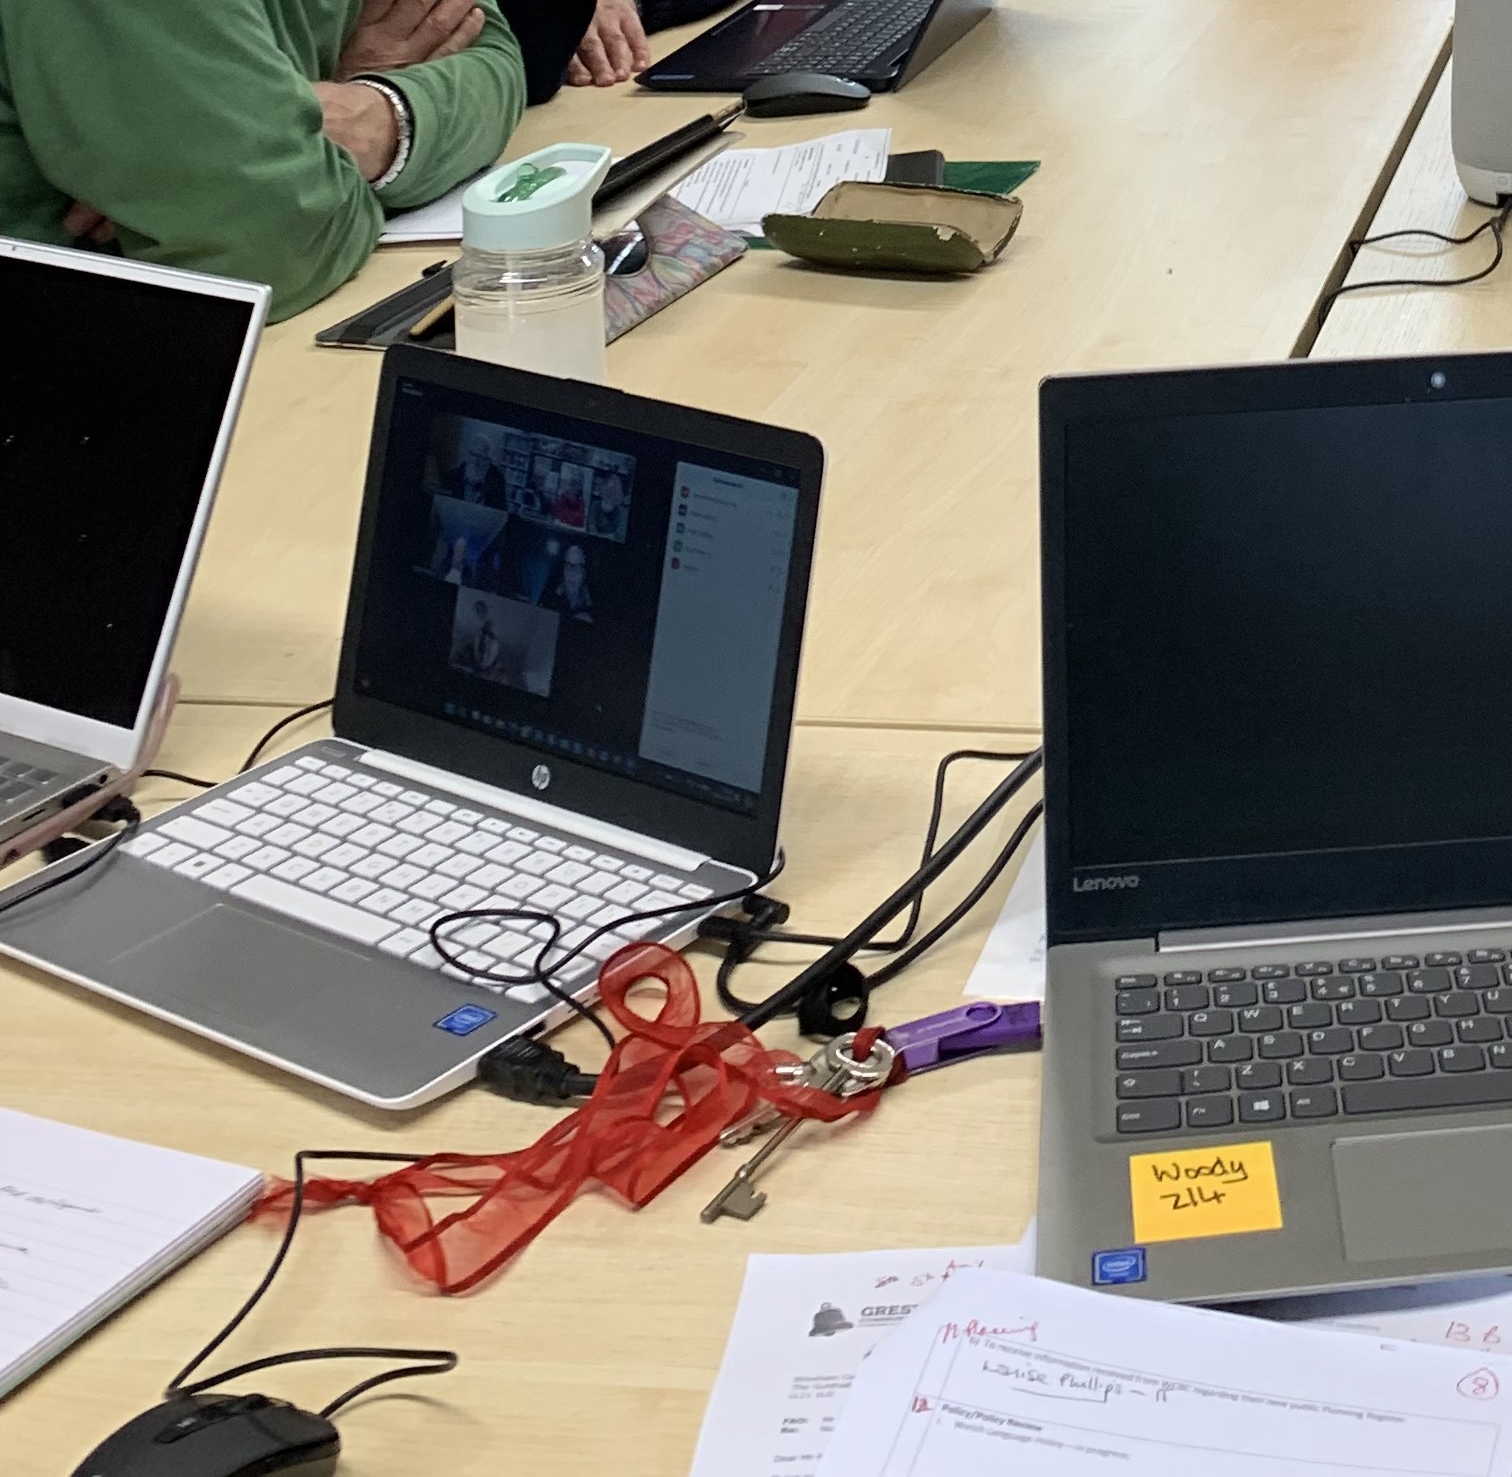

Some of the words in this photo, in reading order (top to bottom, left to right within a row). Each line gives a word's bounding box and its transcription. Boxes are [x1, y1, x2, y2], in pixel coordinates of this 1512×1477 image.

[1073, 875, 1140, 893] Lenovo
[1438, 994, 1450, 1004] Y
[1486, 989, 1500, 1001] U
[1391, 998, 1400, 1007] T
[1242, 1009, 1260, 1019] W
[1362, 1026, 1374, 1037] F
[1213, 1038, 1226, 1049] A
[1342, 1057, 1356, 1067] C
[1392, 1052, 1406, 1062] V
[1293, 1060, 1305, 1071] X
[1152, 1157, 1248, 1184] Woody
[1472, 1376, 1489, 1396] 8
[942, 1403, 1005, 1427] Policy/Policy
[1006, 1417, 1043, 1431] Review
